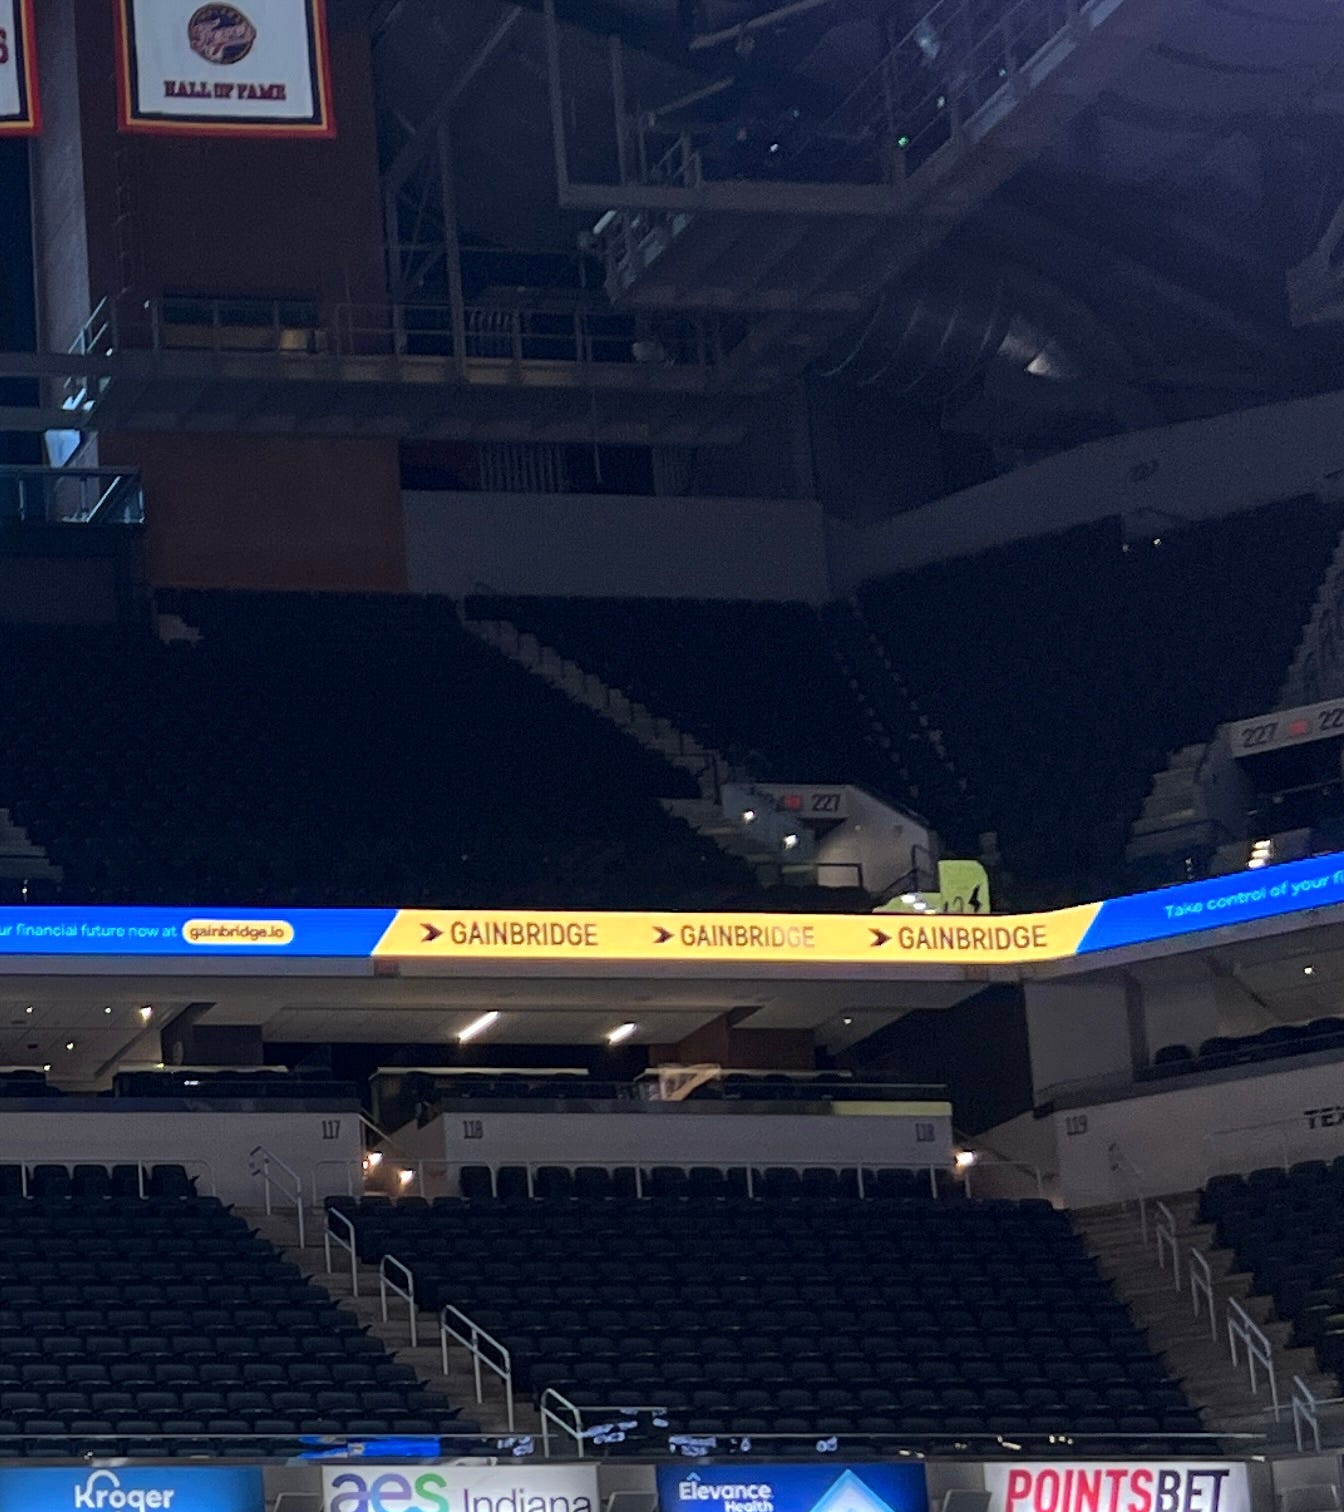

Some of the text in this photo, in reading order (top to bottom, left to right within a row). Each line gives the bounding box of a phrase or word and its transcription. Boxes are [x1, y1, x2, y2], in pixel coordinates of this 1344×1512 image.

[163, 80, 287, 101] HALL OF FAME
[1241, 707, 1344, 748] 227 22
[812, 794, 841, 812] 227
[1165, 902, 1204, 919] Take
[1206, 887, 1267, 911] control
[1269, 880, 1288, 897] of
[1290, 874, 1330, 896] your
[15, 922, 78, 937] financial
[80, 923, 125, 938] future
[129, 926, 160, 938] now
[162, 925, 178, 938] at
[189, 924, 285, 940] gainbridge.io
[450, 923, 599, 946] GAINBRIDGE
[680, 925, 816, 949] GAINBRIDGE
[898, 924, 1048, 951] GAINBRIDGE
[322, 1120, 341, 1140] 117
[724, 1499, 774, 1512] Health
